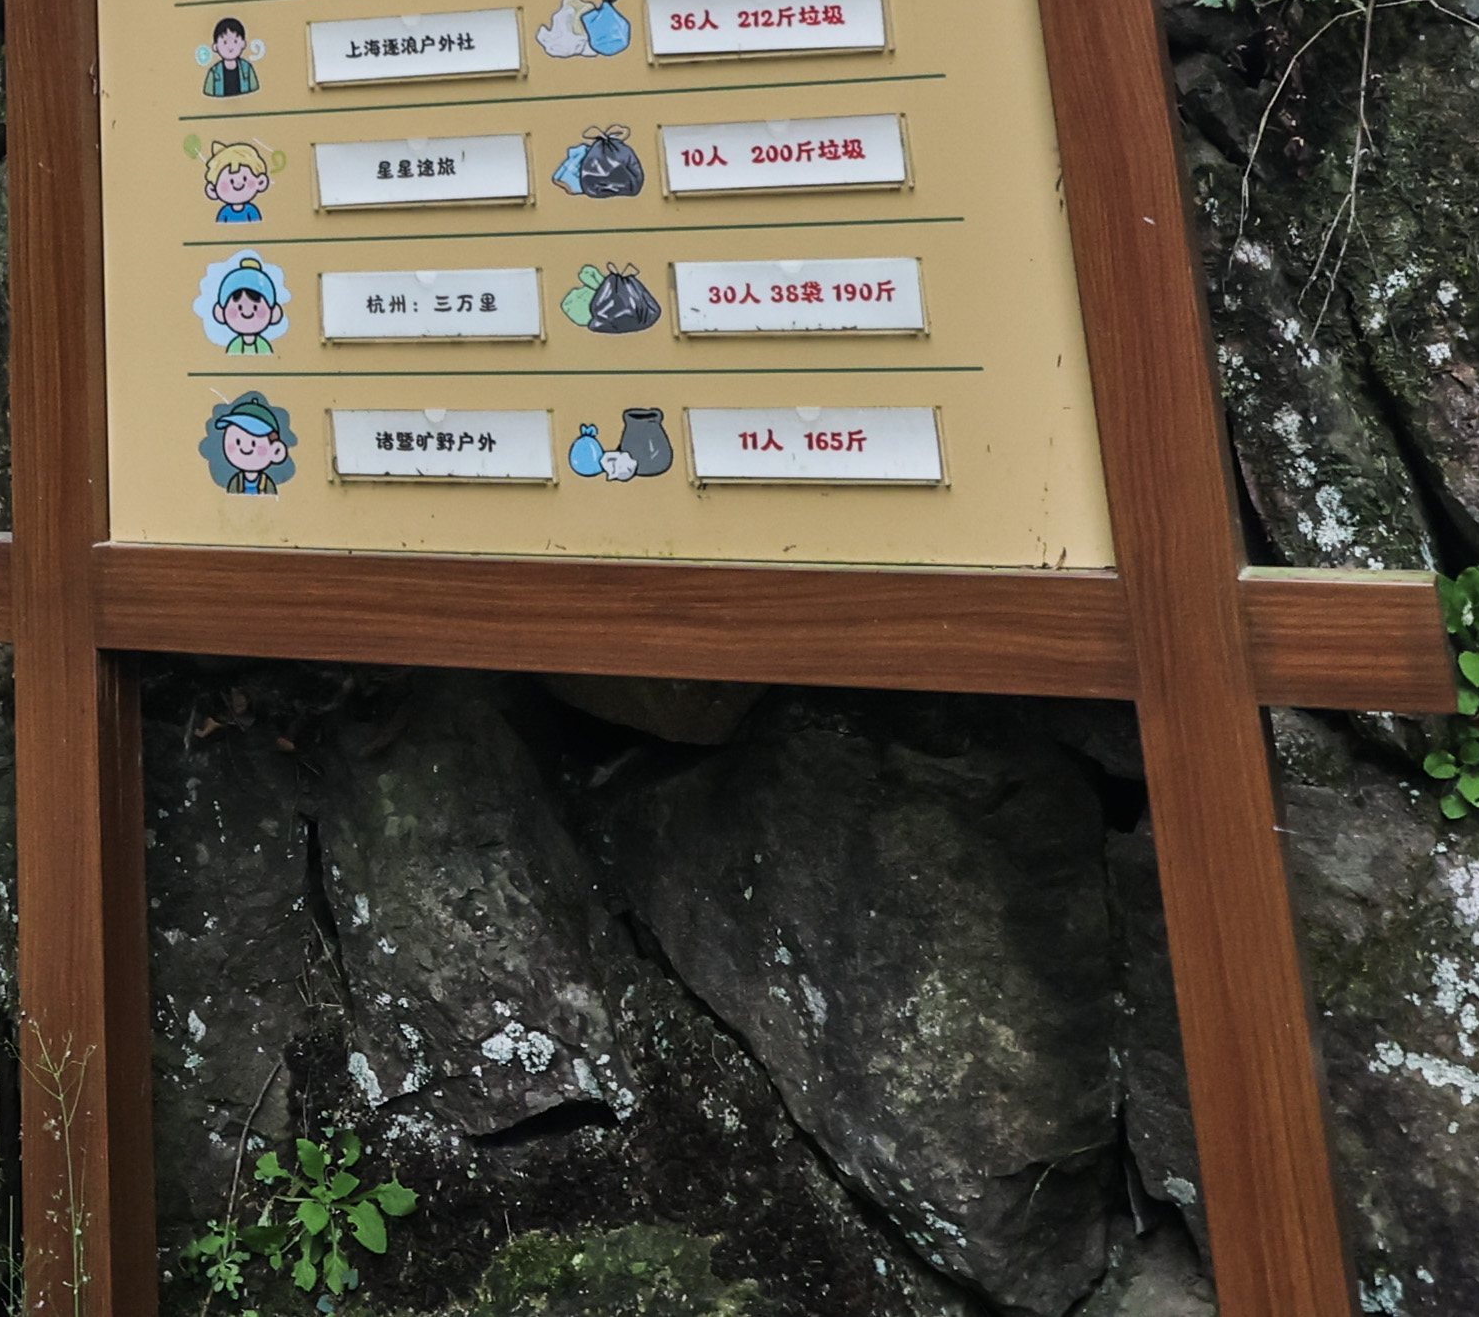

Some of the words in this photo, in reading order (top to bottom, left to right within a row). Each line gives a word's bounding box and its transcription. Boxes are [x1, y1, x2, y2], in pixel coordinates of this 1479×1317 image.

[670, 9, 719, 31] 36人
[737, 4, 846, 28] 212斤垃圾
[345, 32, 476, 59] 上海逐浪户外社
[681, 145, 728, 167] 10人
[751, 138, 866, 164] 200斤垃圾
[376, 157, 457, 180] 星星途旅
[708, 282, 761, 305] 30人
[769, 281, 825, 304] 38袋
[832, 279, 896, 303] 190斤
[375, 431, 497, 453] 诸暨旷野户外
[738, 428, 784, 452] 11人
[803, 429, 868, 453] 165斤
